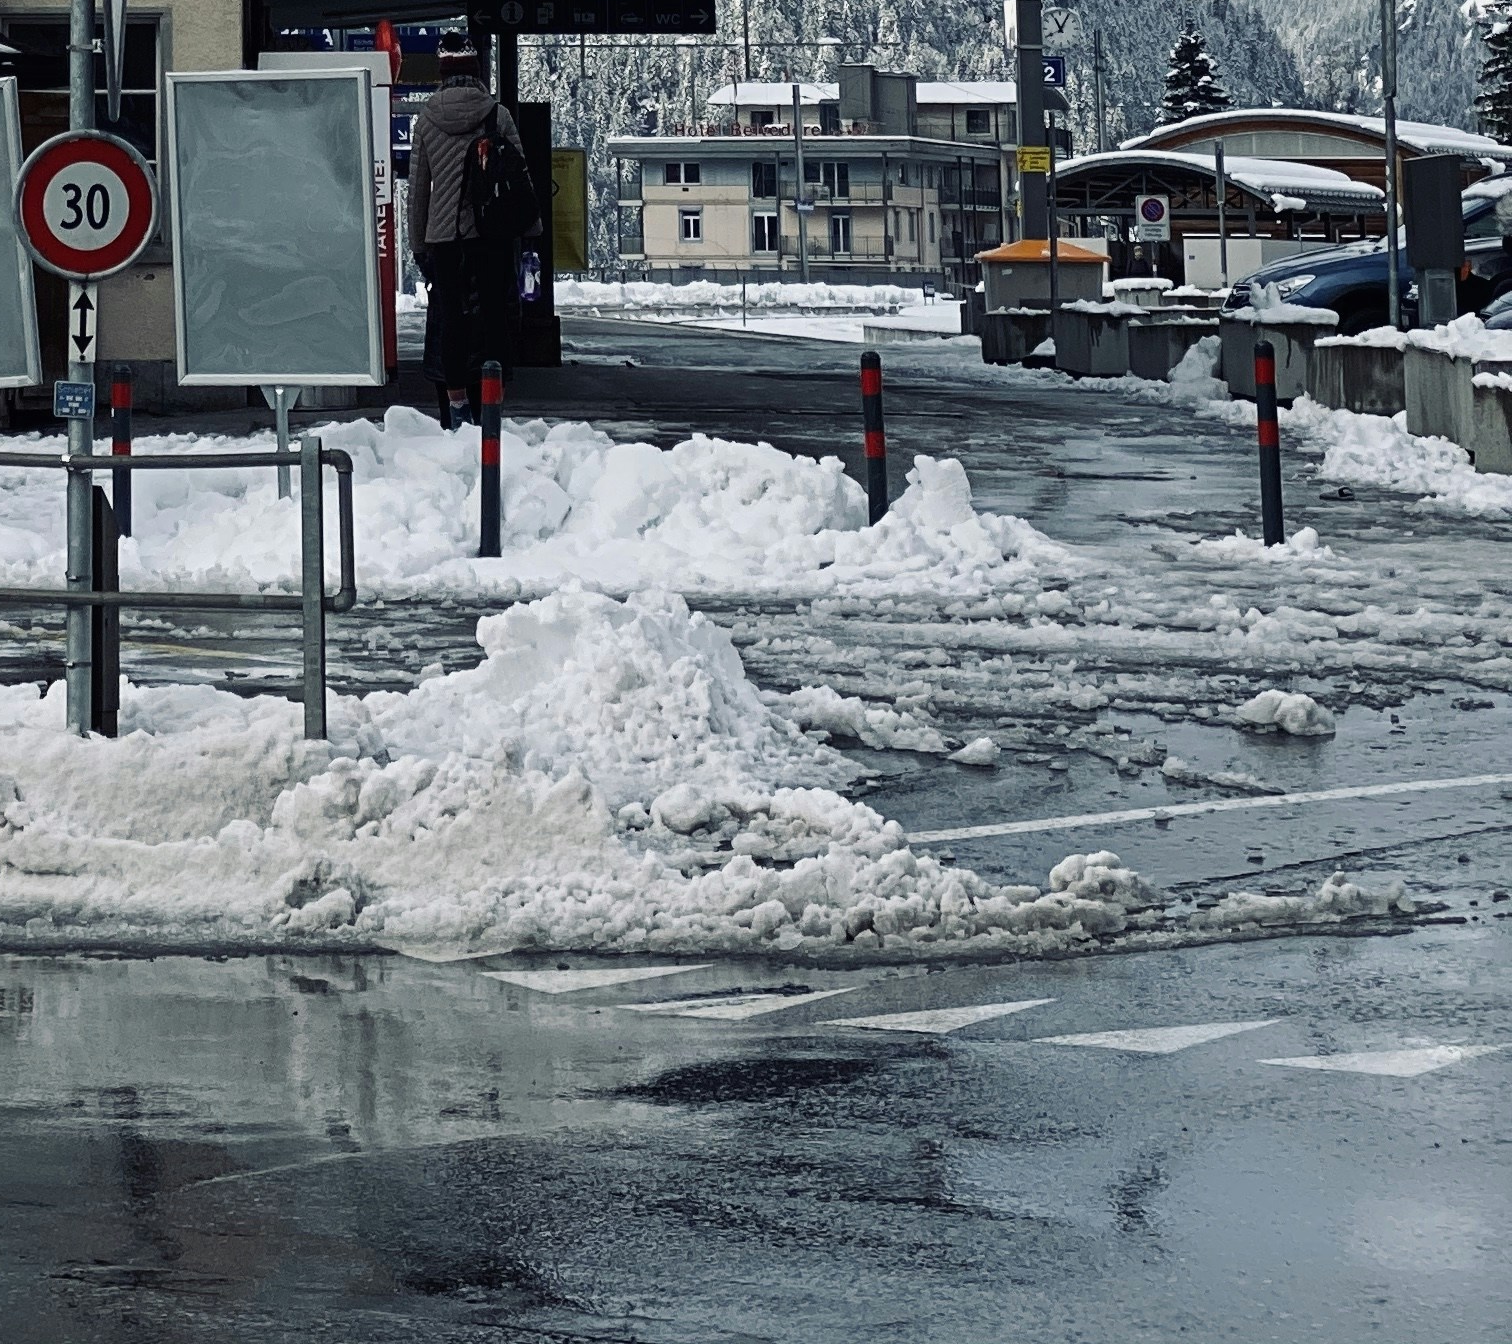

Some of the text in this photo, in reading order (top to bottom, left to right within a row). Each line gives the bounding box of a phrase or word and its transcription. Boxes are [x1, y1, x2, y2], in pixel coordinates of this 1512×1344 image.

[655, 13, 681, 25] WC
[1043, 66, 1056, 82] 2
[730, 122, 822, 137] Belvedre
[59, 183, 110, 230] 30
